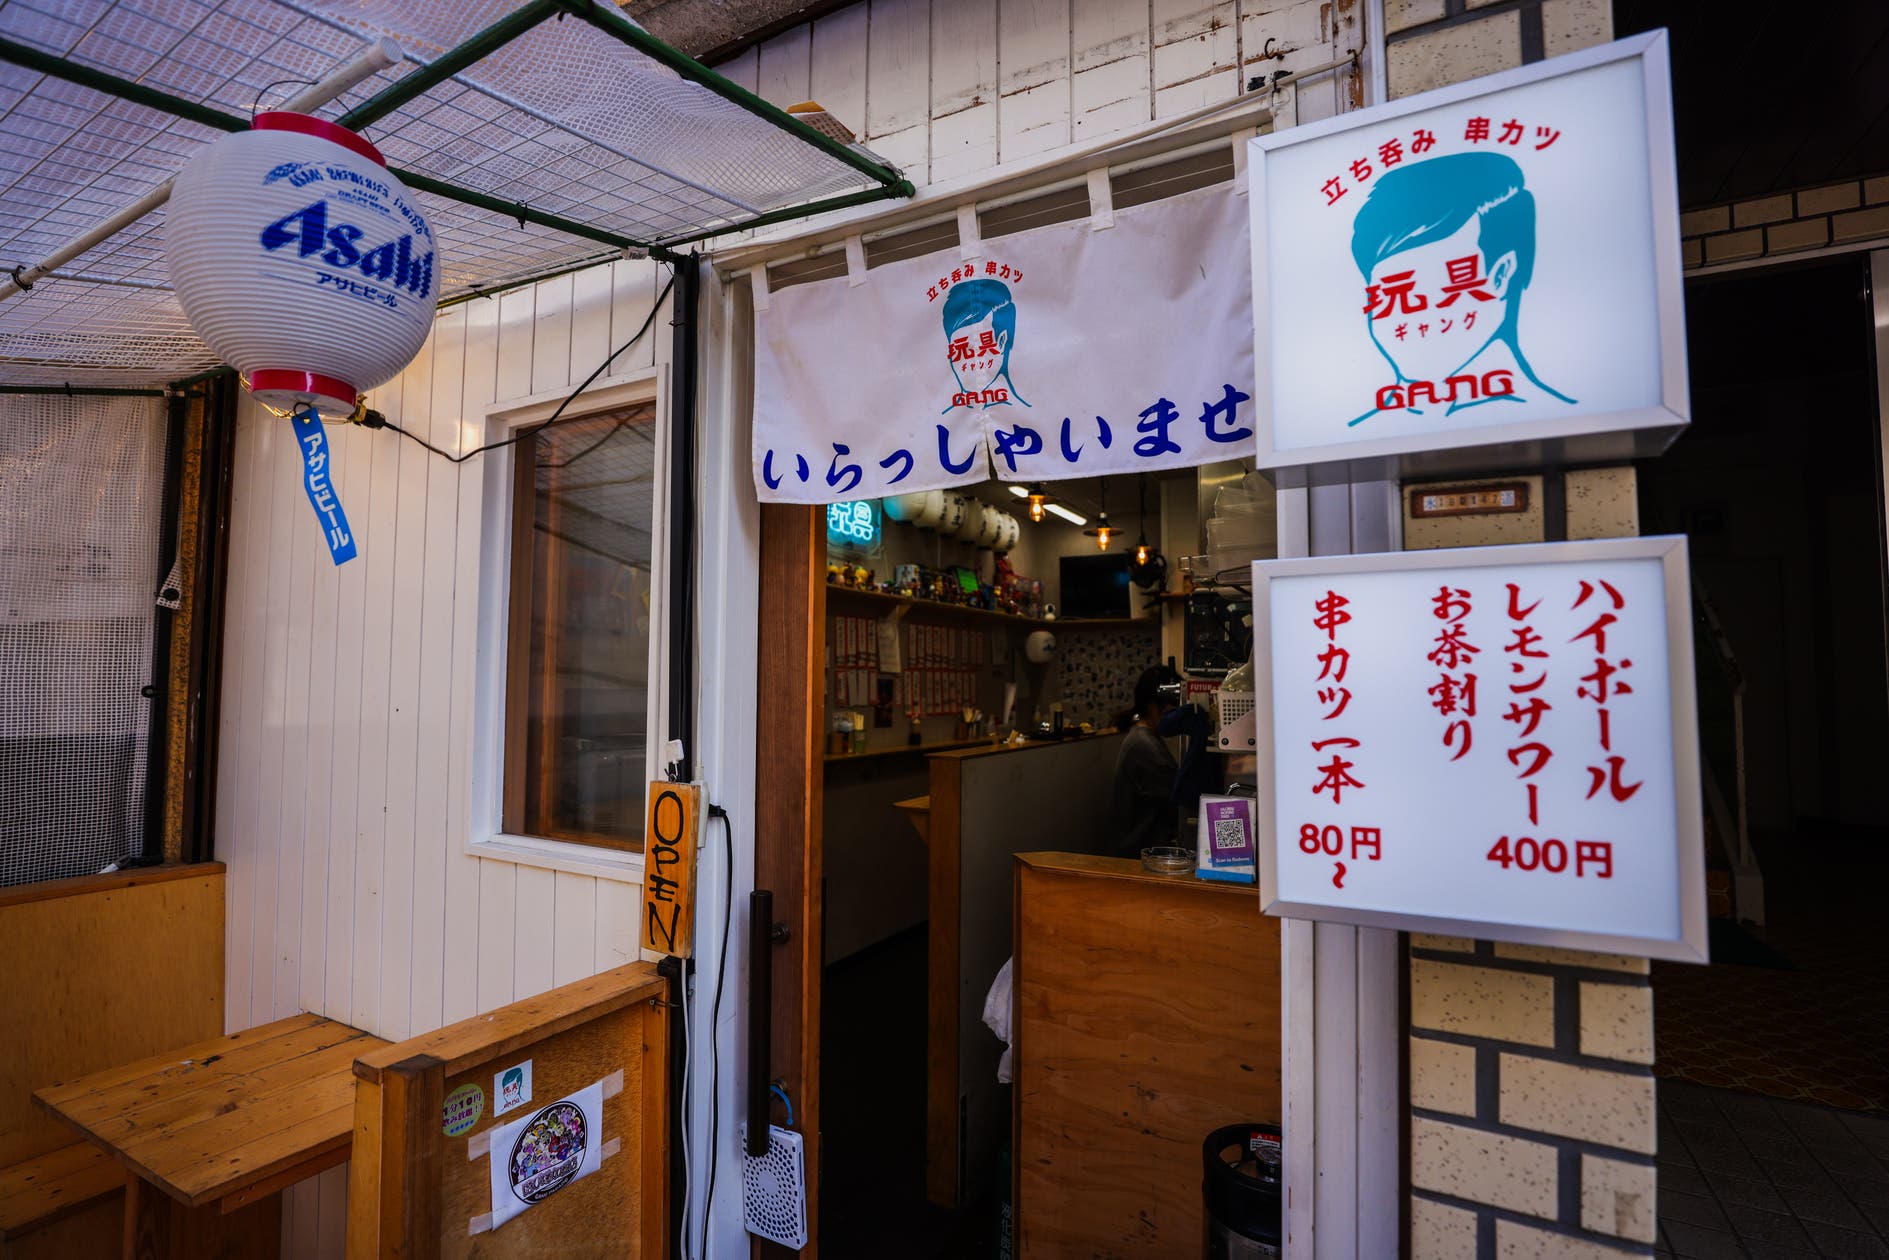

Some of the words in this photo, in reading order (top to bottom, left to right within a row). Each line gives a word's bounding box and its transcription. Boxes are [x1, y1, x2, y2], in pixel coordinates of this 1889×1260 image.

[1320, 127, 1437, 206] 立ち呑み
[1463, 115, 1562, 152] 串カツ
[315, 271, 399, 308] アサヒビール
[926, 263, 975, 302] 立ち呑み
[984, 261, 1024, 284] 串カツ
[1362, 253, 1497, 321] 玩具
[946, 330, 1001, 363] 玩具
[1394, 310, 1479, 342] ギャング
[951, 388, 1009, 407] GANG
[1375, 369, 1515, 412] GANG
[762, 384, 1254, 494] いらっしゃいませ
[303, 431, 350, 551] アサヒビール
[1311, 589, 1367, 805] 串カツ一本
[1426, 585, 1482, 763] お茶割り
[1502, 582, 1555, 827] レモンサワー
[1568, 578, 1646, 803] ハイボール
[647, 790, 685, 953] OPEN
[1486, 835, 1614, 879] 400円
